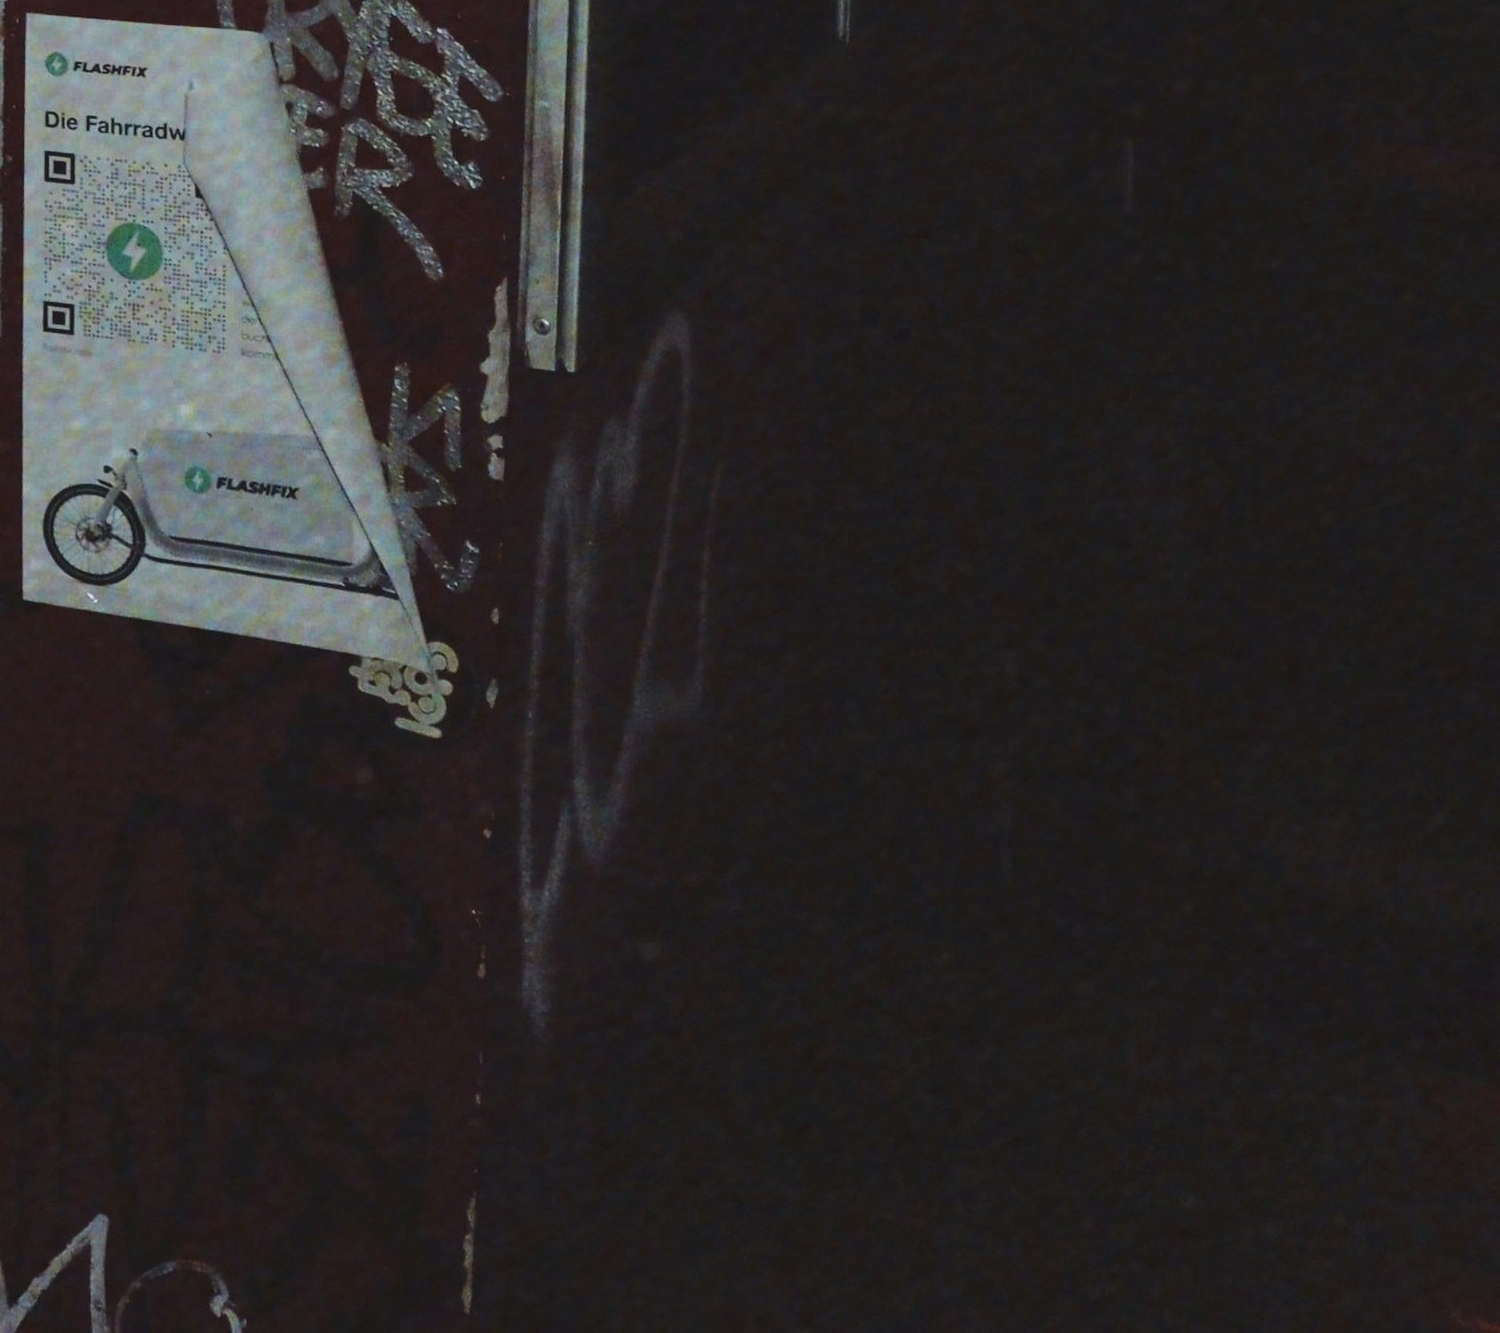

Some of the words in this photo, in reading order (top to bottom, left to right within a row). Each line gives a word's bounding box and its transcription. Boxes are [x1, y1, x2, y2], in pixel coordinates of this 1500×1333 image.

[73, 61, 147, 78] FLASHFIX
[45, 111, 78, 130] Die
[216, 476, 299, 500] FLASHFIX
